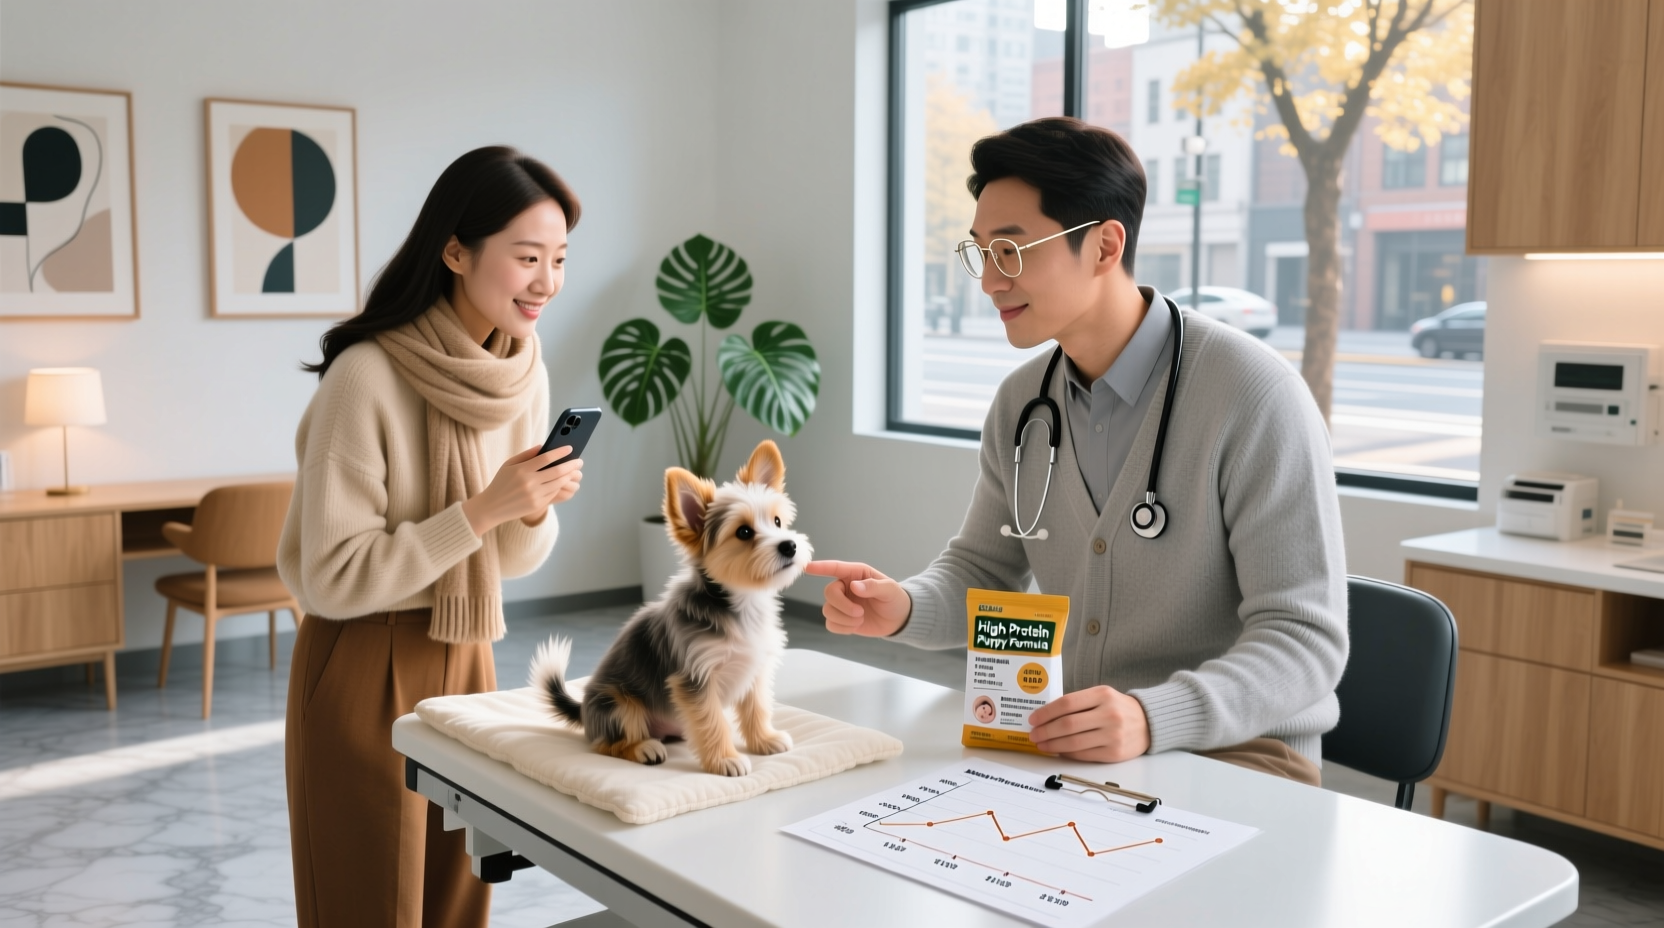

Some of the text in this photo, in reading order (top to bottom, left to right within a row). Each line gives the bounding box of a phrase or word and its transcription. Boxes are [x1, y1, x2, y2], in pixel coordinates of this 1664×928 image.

[978, 619, 1050, 639] High Protein
[977, 634, 1049, 650] Puppy Formula
